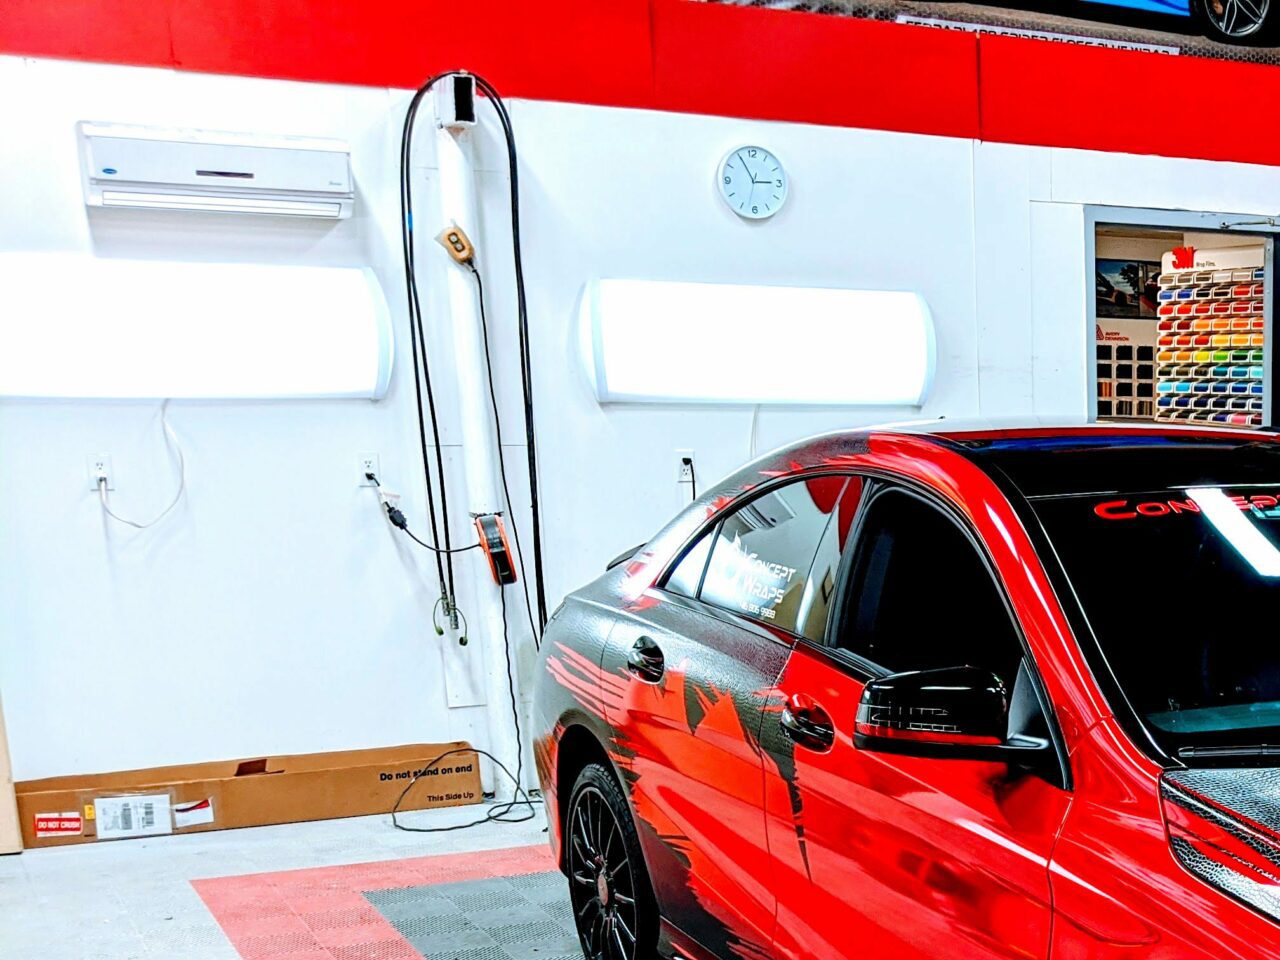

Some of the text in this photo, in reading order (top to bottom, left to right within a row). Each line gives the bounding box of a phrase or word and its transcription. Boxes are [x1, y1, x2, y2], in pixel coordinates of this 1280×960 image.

[748, 149, 757, 158] 12
[724, 176, 732, 185] 9
[776, 179, 783, 188] 3
[751, 205, 759, 214] 6
[1172, 246, 1196, 269] 3M
[380, 772, 393, 781] Do
[396, 770, 410, 779] not
[441, 767, 453, 775] on
[455, 764, 473, 773] end
[38, 821, 47, 829] DO
